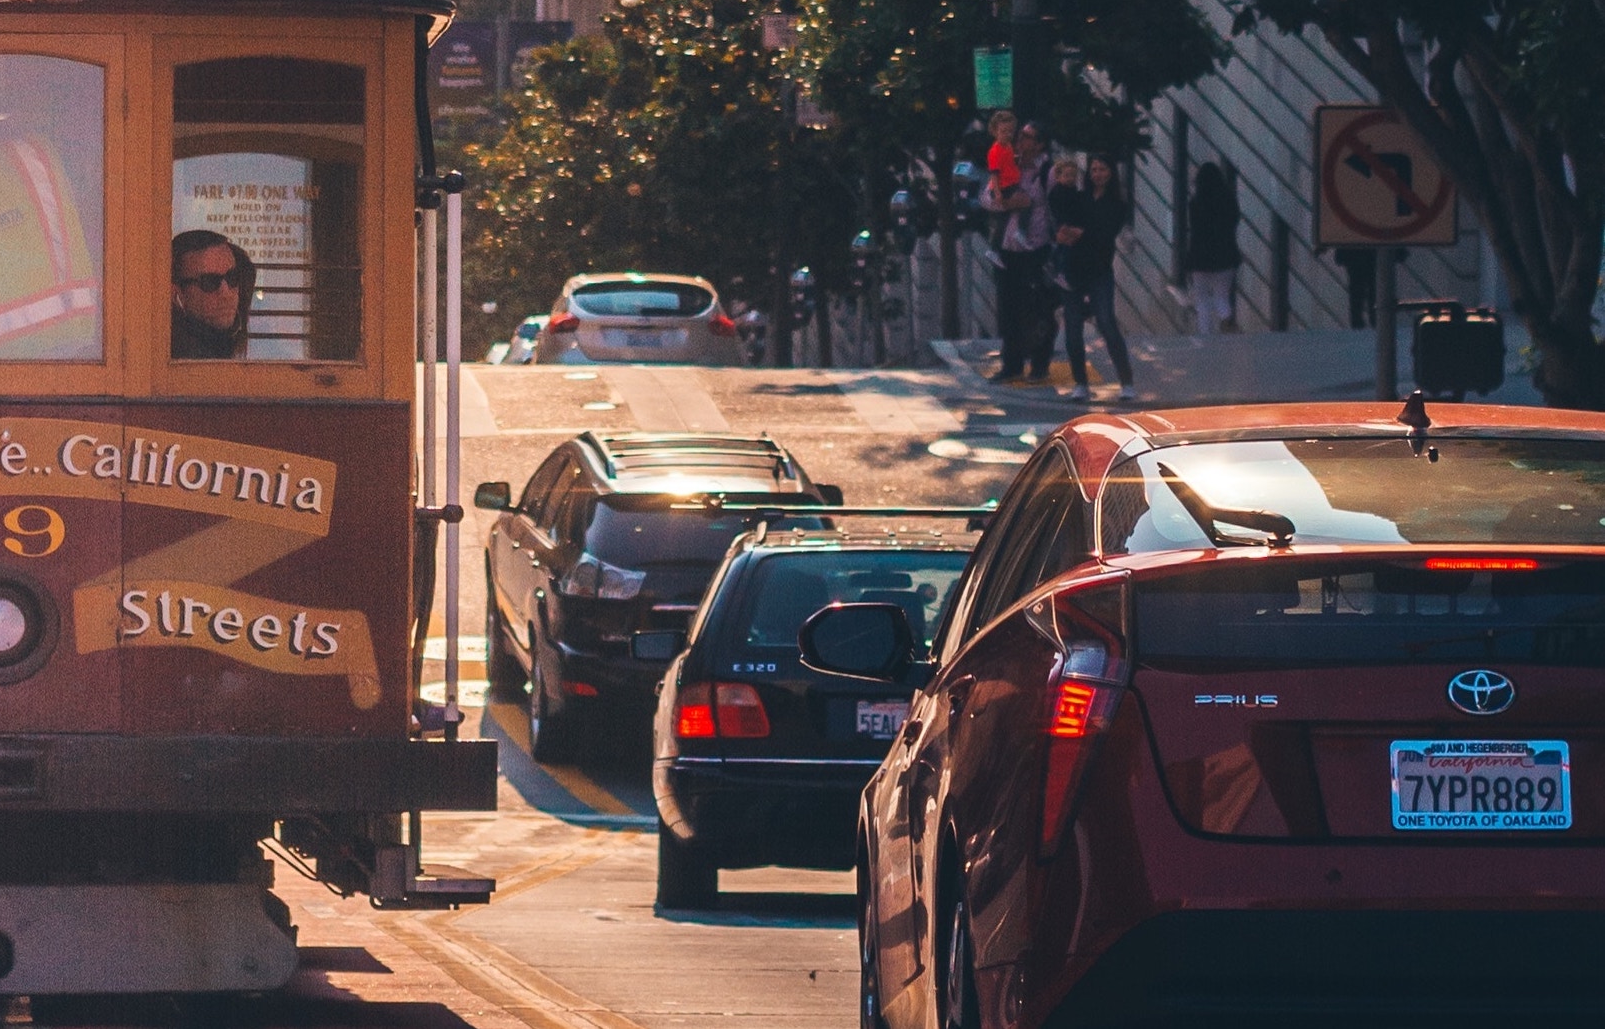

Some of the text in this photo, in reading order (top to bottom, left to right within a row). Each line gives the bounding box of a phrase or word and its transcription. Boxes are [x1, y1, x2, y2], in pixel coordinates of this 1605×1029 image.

[194, 184, 224, 199] FARE
[261, 185, 287, 200] ONE
[233, 203, 281, 211] HOLD ON
[233, 214, 272, 222] YELLOW
[61, 432, 326, 514] California
[121, 587, 344, 657] Streets
[732, 663, 777, 672] E 320
[1194, 694, 1278, 708] PRIUS
[1447, 743, 1464, 753] AND
[1466, 743, 1529, 754] HEGENBERGER
[1428, 756, 1536, 774] California
[1404, 775, 1557, 813] 7YPR889
[1398, 815, 1567, 827] ONE TOYOTA OF OAKLAND
